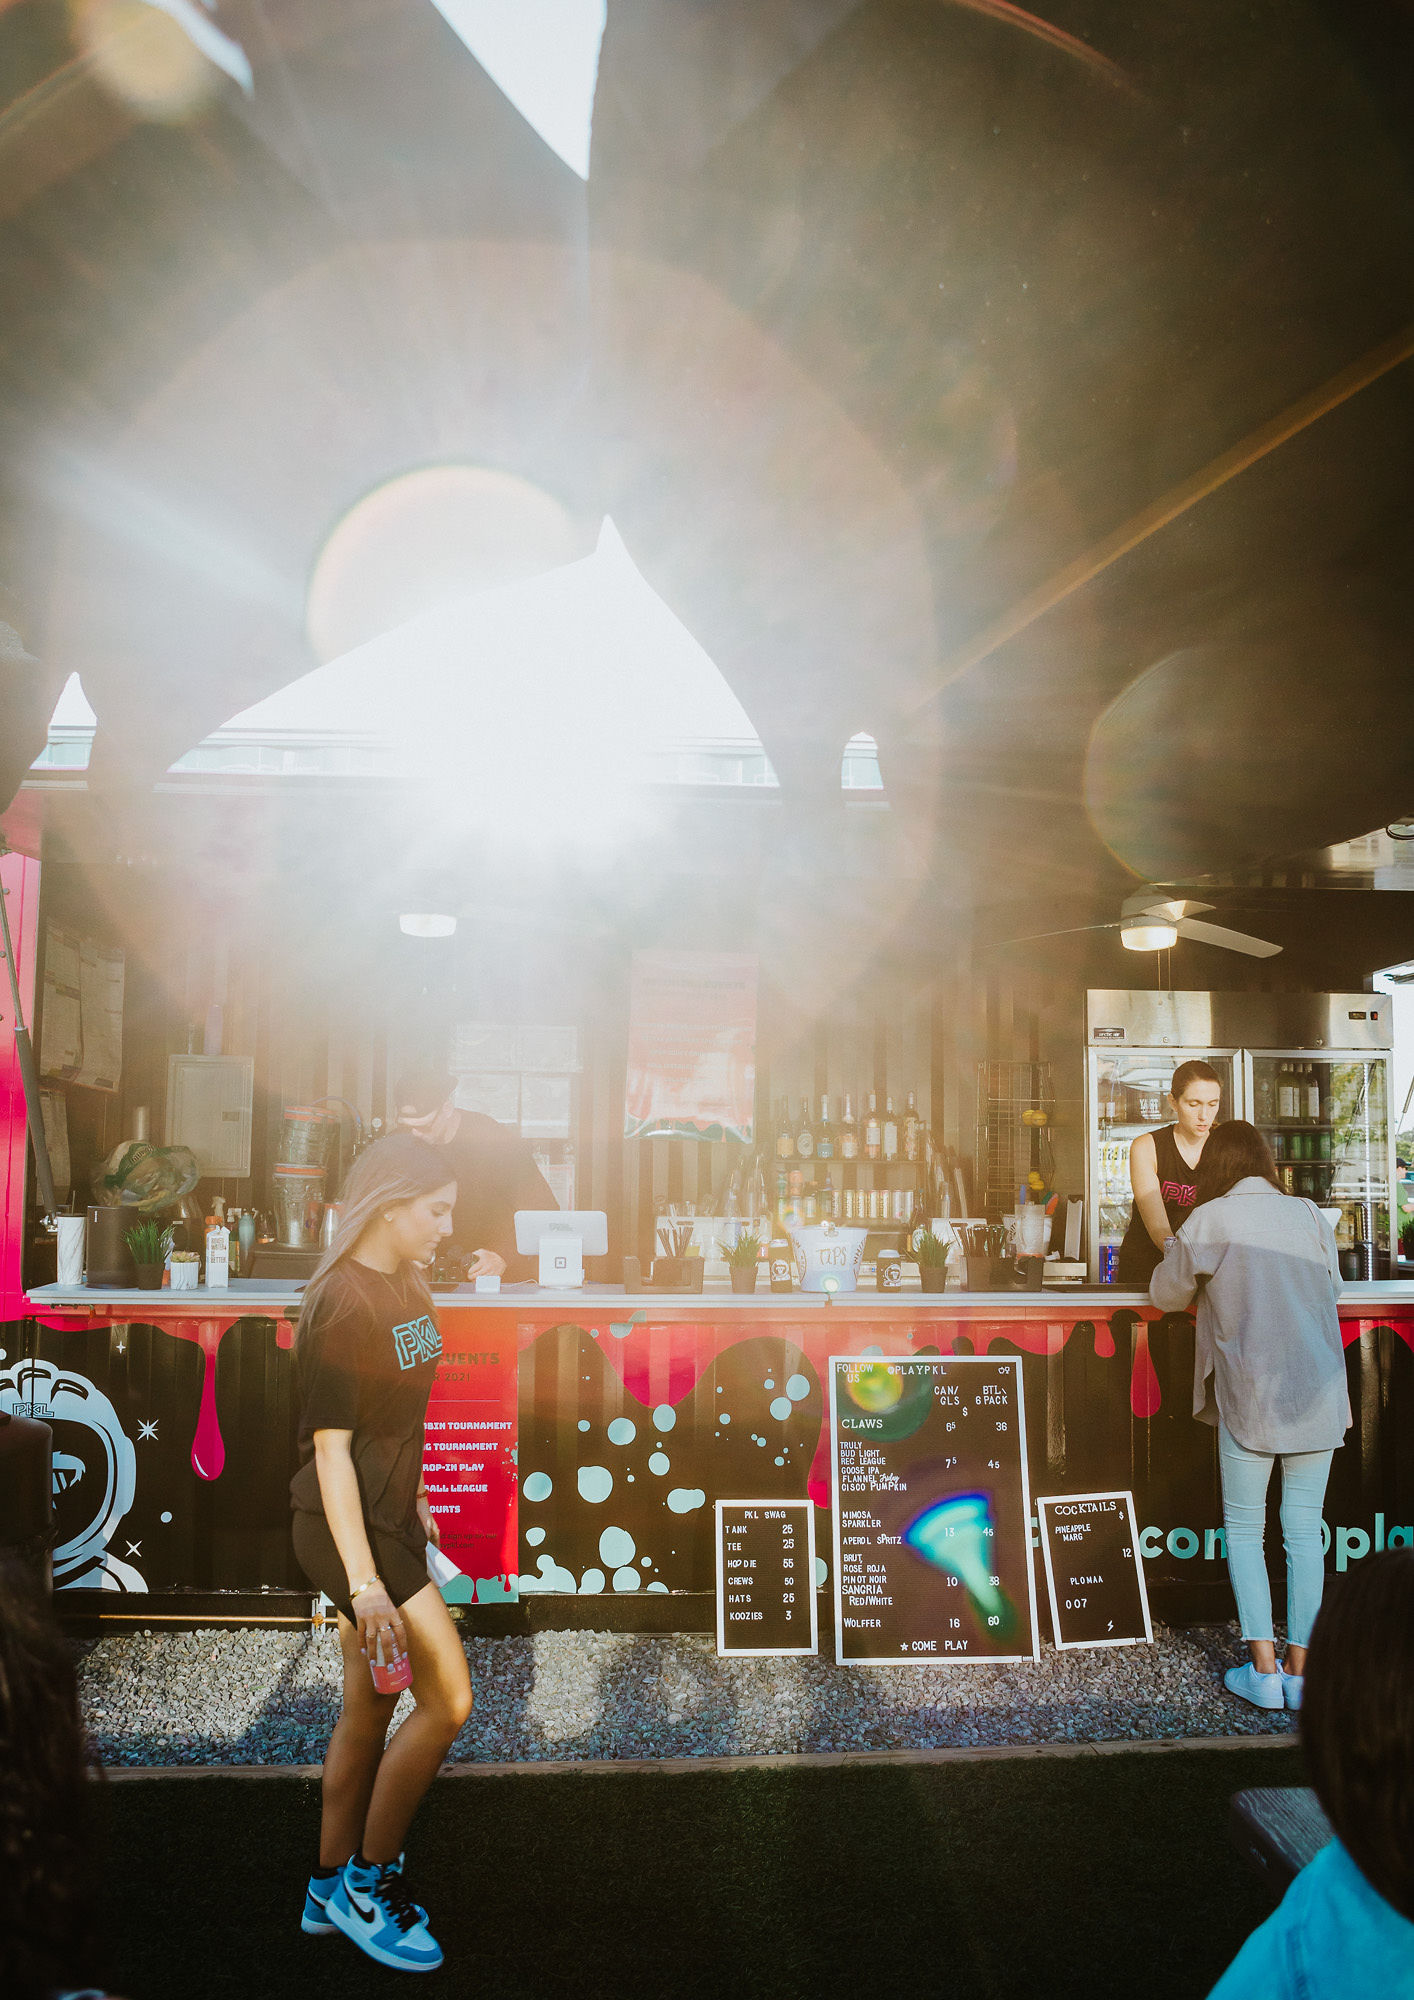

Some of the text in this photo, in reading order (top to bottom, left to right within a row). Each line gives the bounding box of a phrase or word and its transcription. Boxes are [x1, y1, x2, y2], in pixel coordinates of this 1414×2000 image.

[837, 1363, 947, 1375] FOLLOW @PLAYPKL
[847, 1374, 860, 1383] US
[934, 1386, 959, 1395] CAN/
[940, 1396, 1008, 1405] GLS 6 PACK
[12, 1402, 54, 1417] PKL
[962, 1407, 968, 1416] $
[447, 1422, 512, 1430] TOURNAMENT
[841, 1419, 883, 1429] CLAWS
[996, 1422, 1007, 1431] 36
[433, 1443, 498, 1451] TOURNAMENT
[840, 1441, 862, 1449] TRULY
[859, 1449, 880, 1457] LIGHT
[840, 1457, 886, 1465] REC LEAGUE
[988, 1460, 1000, 1469] 45
[422, 1463, 484, 1472] ROP-IN PLAY
[841, 1466, 879, 1475] GOOSE IPA
[842, 1475, 877, 1483] FLANNEL
[424, 1484, 488, 1492] BALL LEAGUE
[841, 1481, 907, 1491] CISCO PUMPKIN
[429, 1505, 461, 1513] OURTS
[1054, 1501, 1116, 1516] COCKTAILS
[744, 1510, 786, 1519] PKL SWAG
[842, 1511, 871, 1519] MIMOSA
[1118, 1511, 1124, 1520] $
[842, 1519, 881, 1528] SPARKLER
[725, 1524, 793, 1534] TANK 25
[944, 1528, 955, 1537] 13
[1055, 1523, 1091, 1535] PINEAPPLE
[843, 1533, 901, 1545] APEROL SPRITZ
[1062, 1533, 1083, 1542] MARG
[1321, 1512, 1414, 1572] pla
[727, 1539, 794, 1551] TEE 25
[1122, 1548, 1132, 1558] 12
[727, 1558, 794, 1568] HOODIE 55
[843, 1564, 886, 1573] ROSE ROJA
[728, 1577, 794, 1586] CREWS 50
[843, 1576, 887, 1584] PINOT NOIR
[946, 1576, 1000, 1586] 10 38
[842, 1585, 883, 1595] SANGRIA
[729, 1593, 794, 1603] HATS 25
[730, 1610, 792, 1620] KOOZIES 3
[949, 1619, 960, 1628] 16
[988, 1616, 1000, 1626] 60
[912, 1640, 968, 1651] COME PLAY
